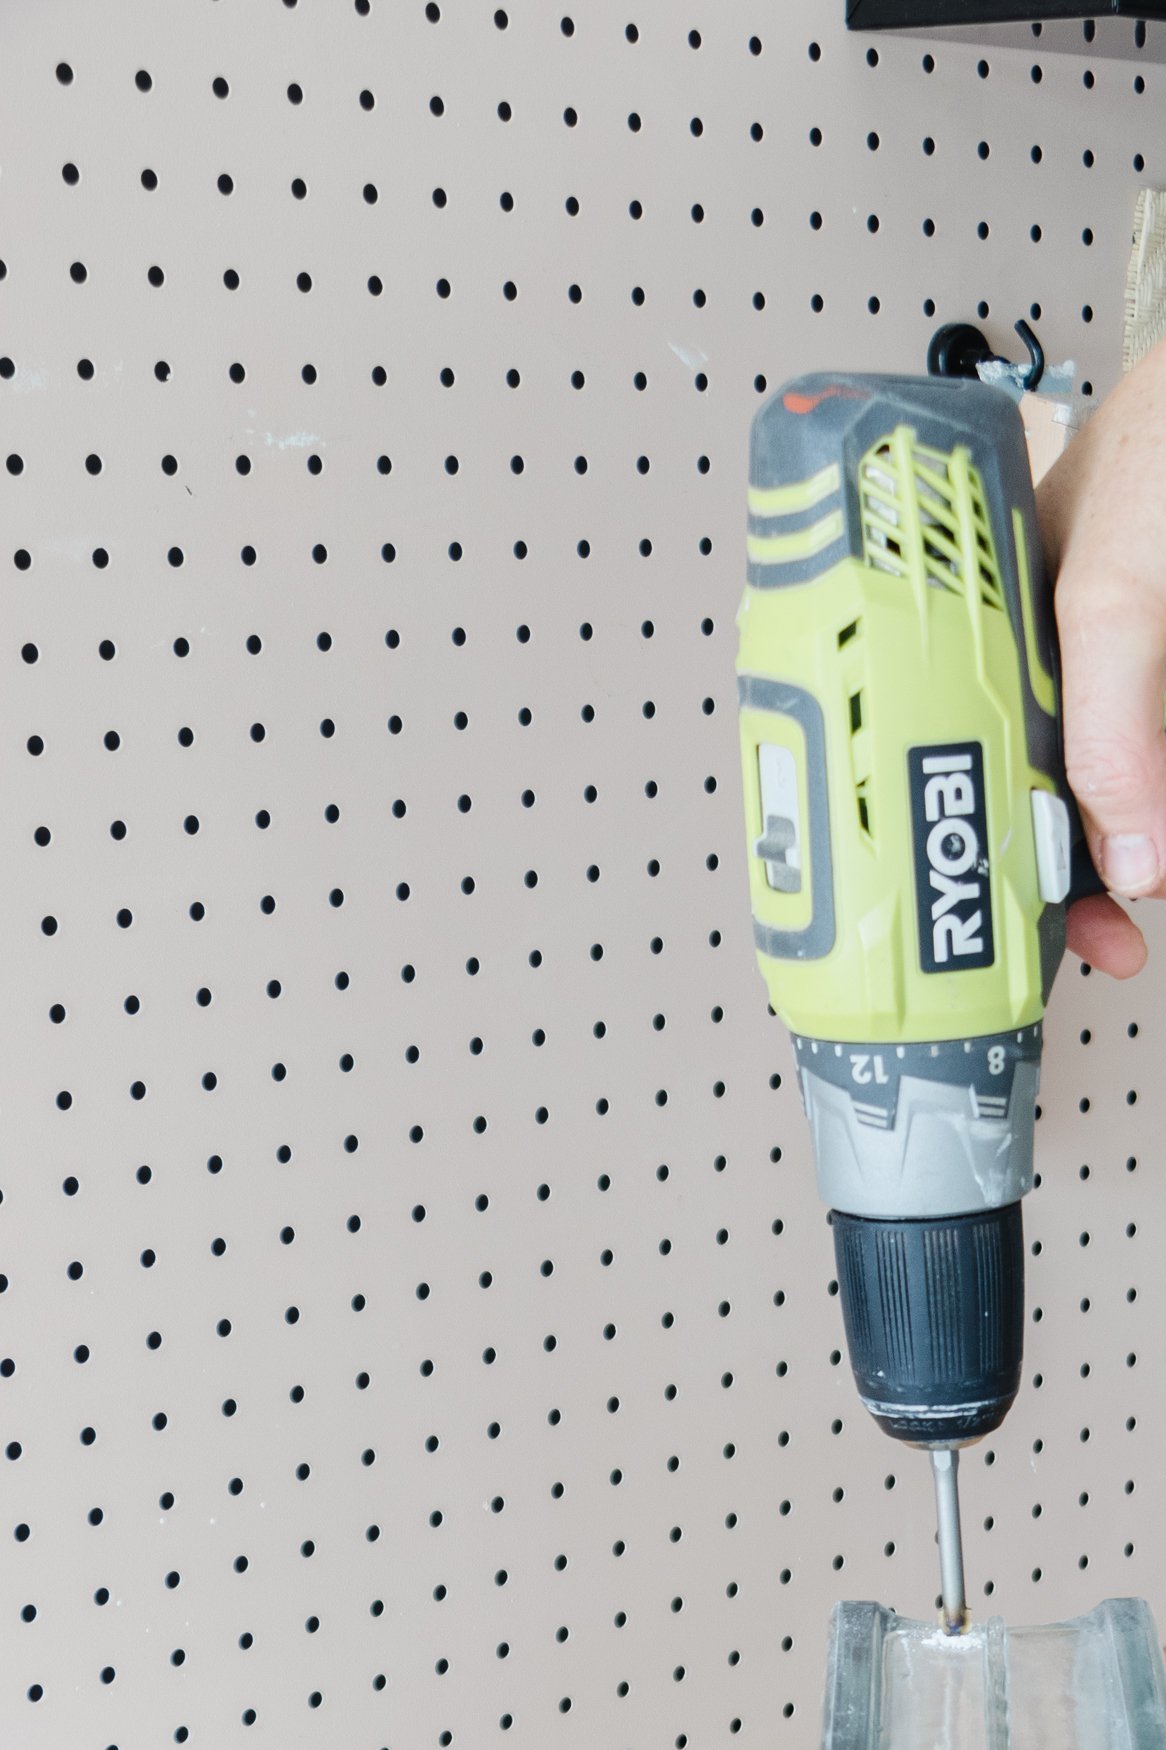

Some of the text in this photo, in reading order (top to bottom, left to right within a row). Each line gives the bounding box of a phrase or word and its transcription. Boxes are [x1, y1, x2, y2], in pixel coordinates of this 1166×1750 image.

[921, 753, 985, 964] RYOBI
[849, 1053, 890, 1085] 12
[986, 1044, 1006, 1076] 8
